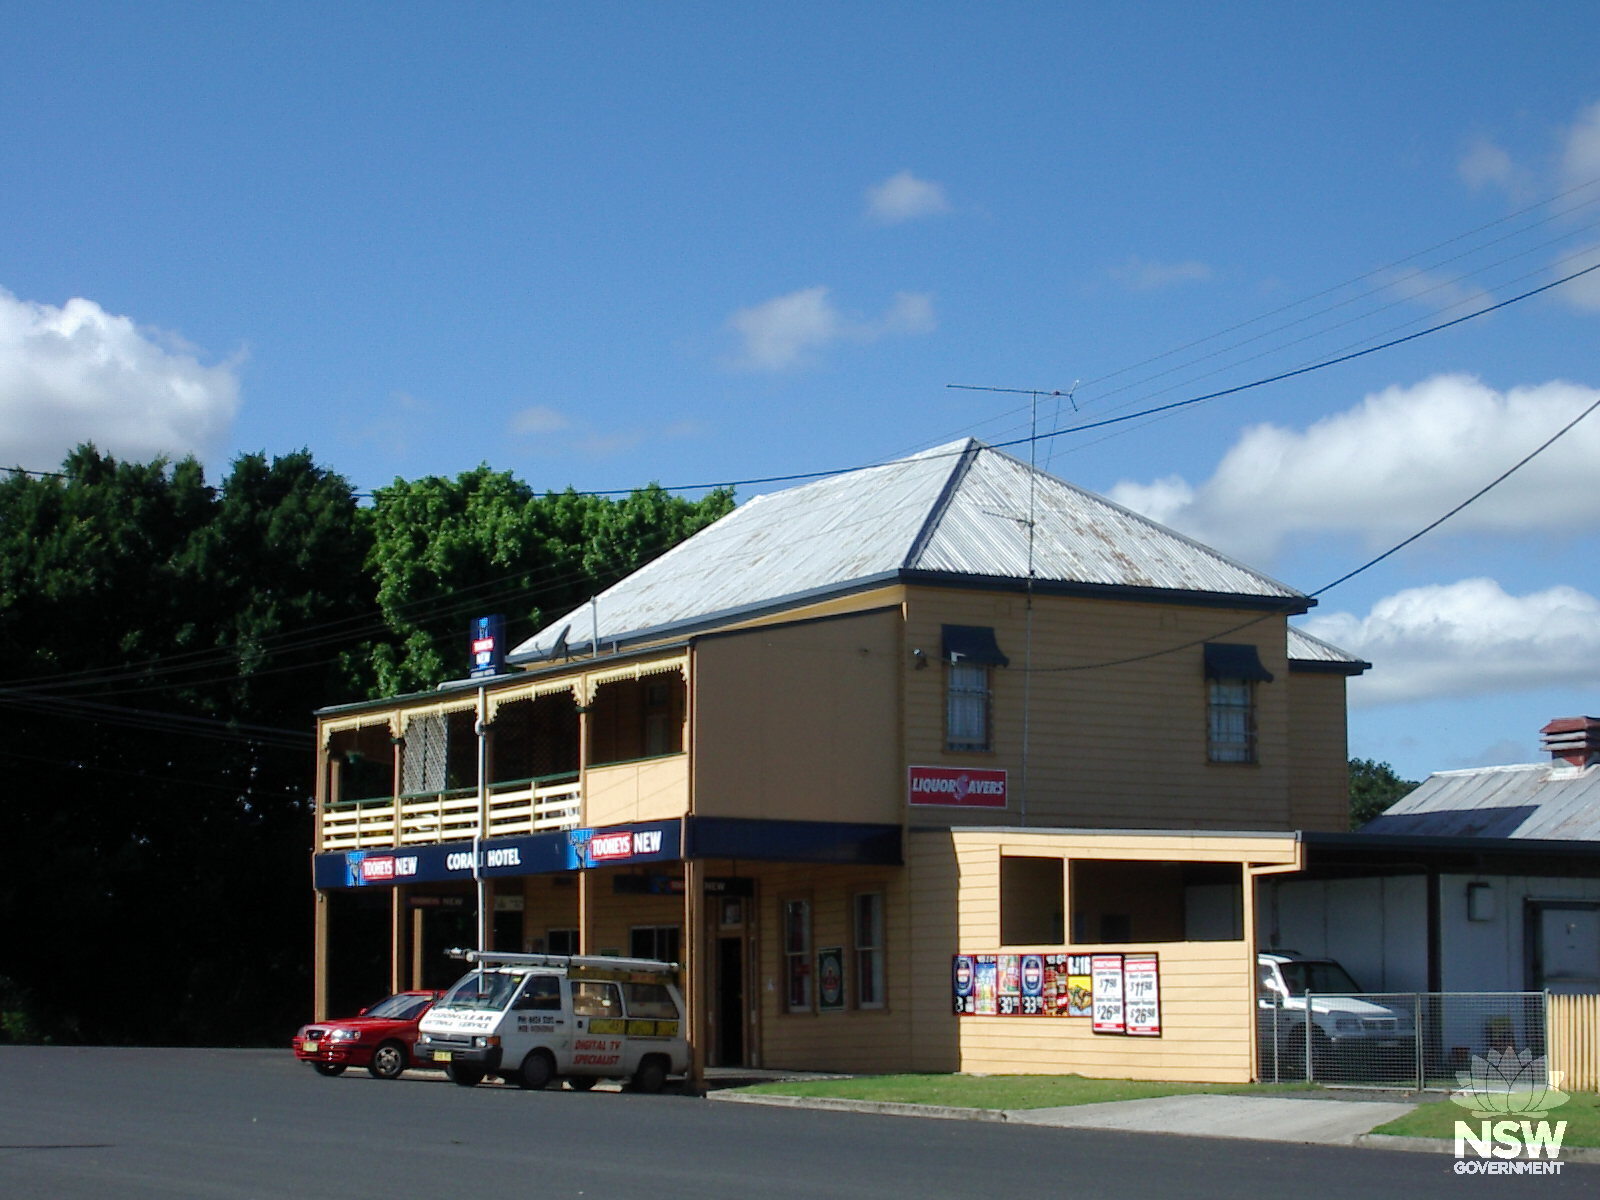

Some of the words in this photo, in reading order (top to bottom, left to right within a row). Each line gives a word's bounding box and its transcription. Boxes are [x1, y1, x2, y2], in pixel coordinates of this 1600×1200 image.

[912, 777, 956, 794] LIQUOR
[592, 836, 631, 856] TOOHEYS
[634, 831, 662, 854] NEW
[395, 856, 418, 876] NEW
[487, 848, 521, 867] HOTEL
[610, 1040, 622, 1050] TV
